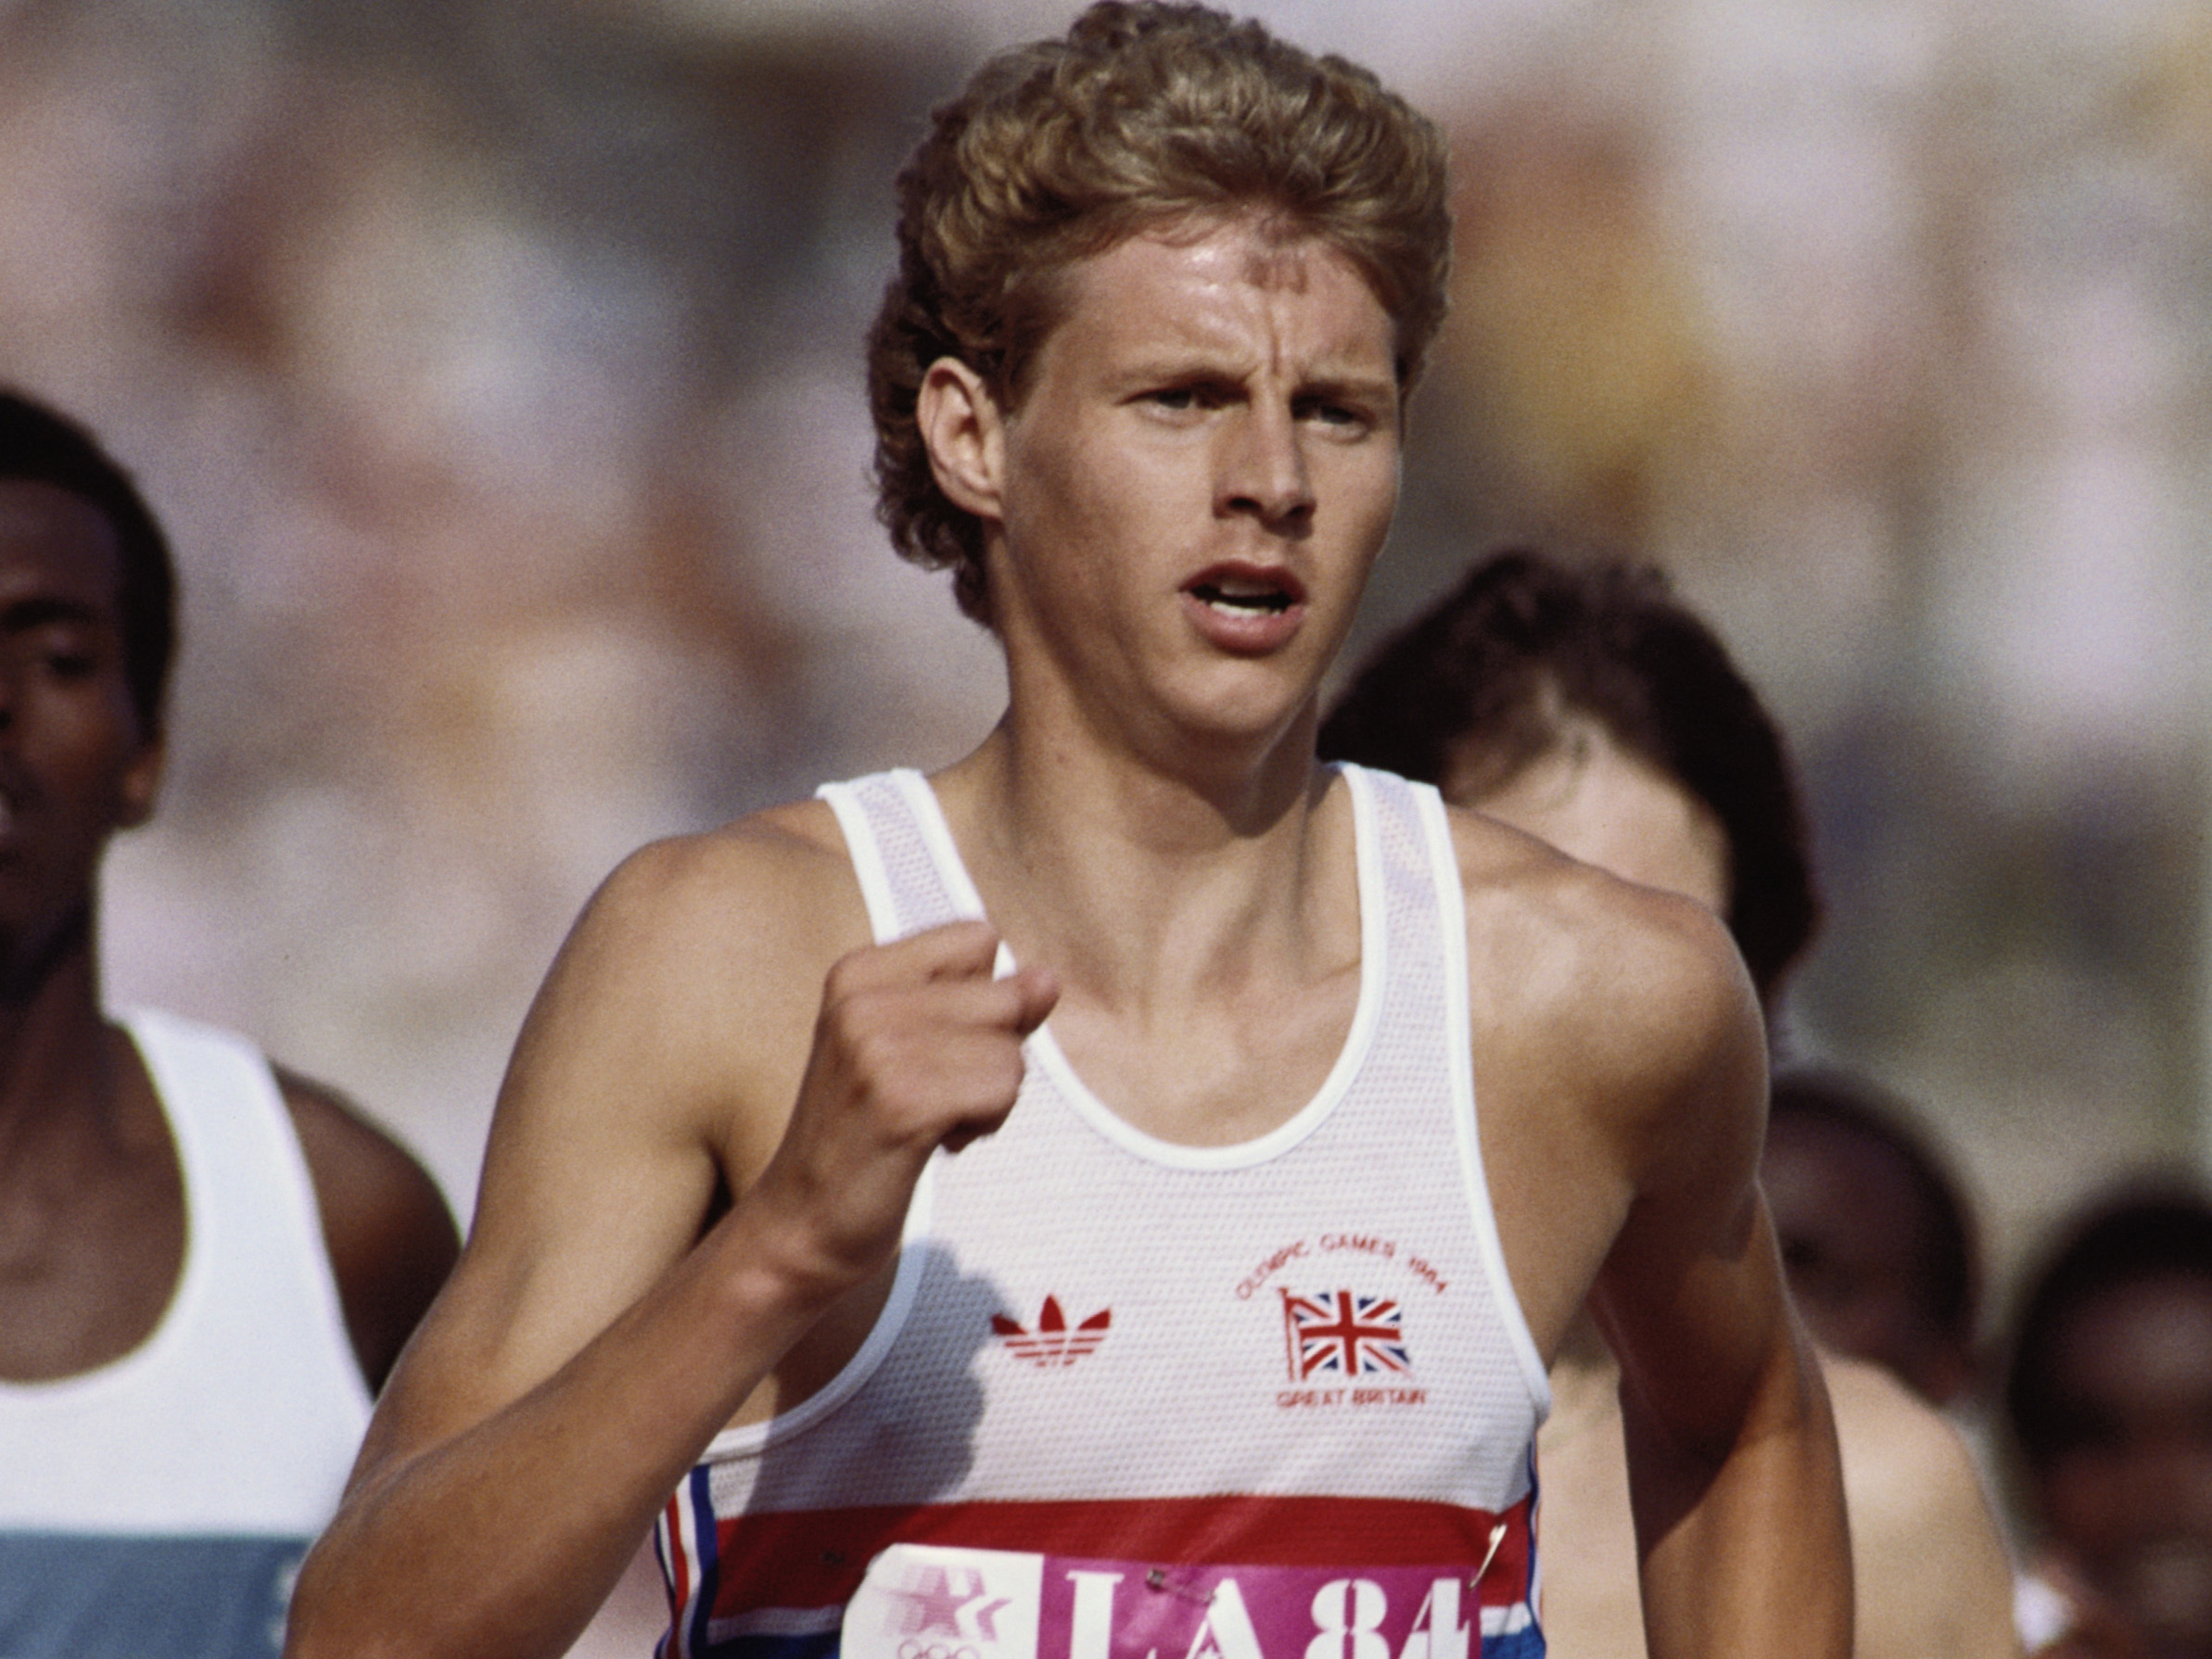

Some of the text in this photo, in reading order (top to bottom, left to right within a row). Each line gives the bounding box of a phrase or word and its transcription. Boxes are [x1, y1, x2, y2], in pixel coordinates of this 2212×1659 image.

[1235, 1234, 1447, 1300] OLYMPIC GAMES 1984
[1277, 1388, 1427, 1408] GREAT BRITAIN
